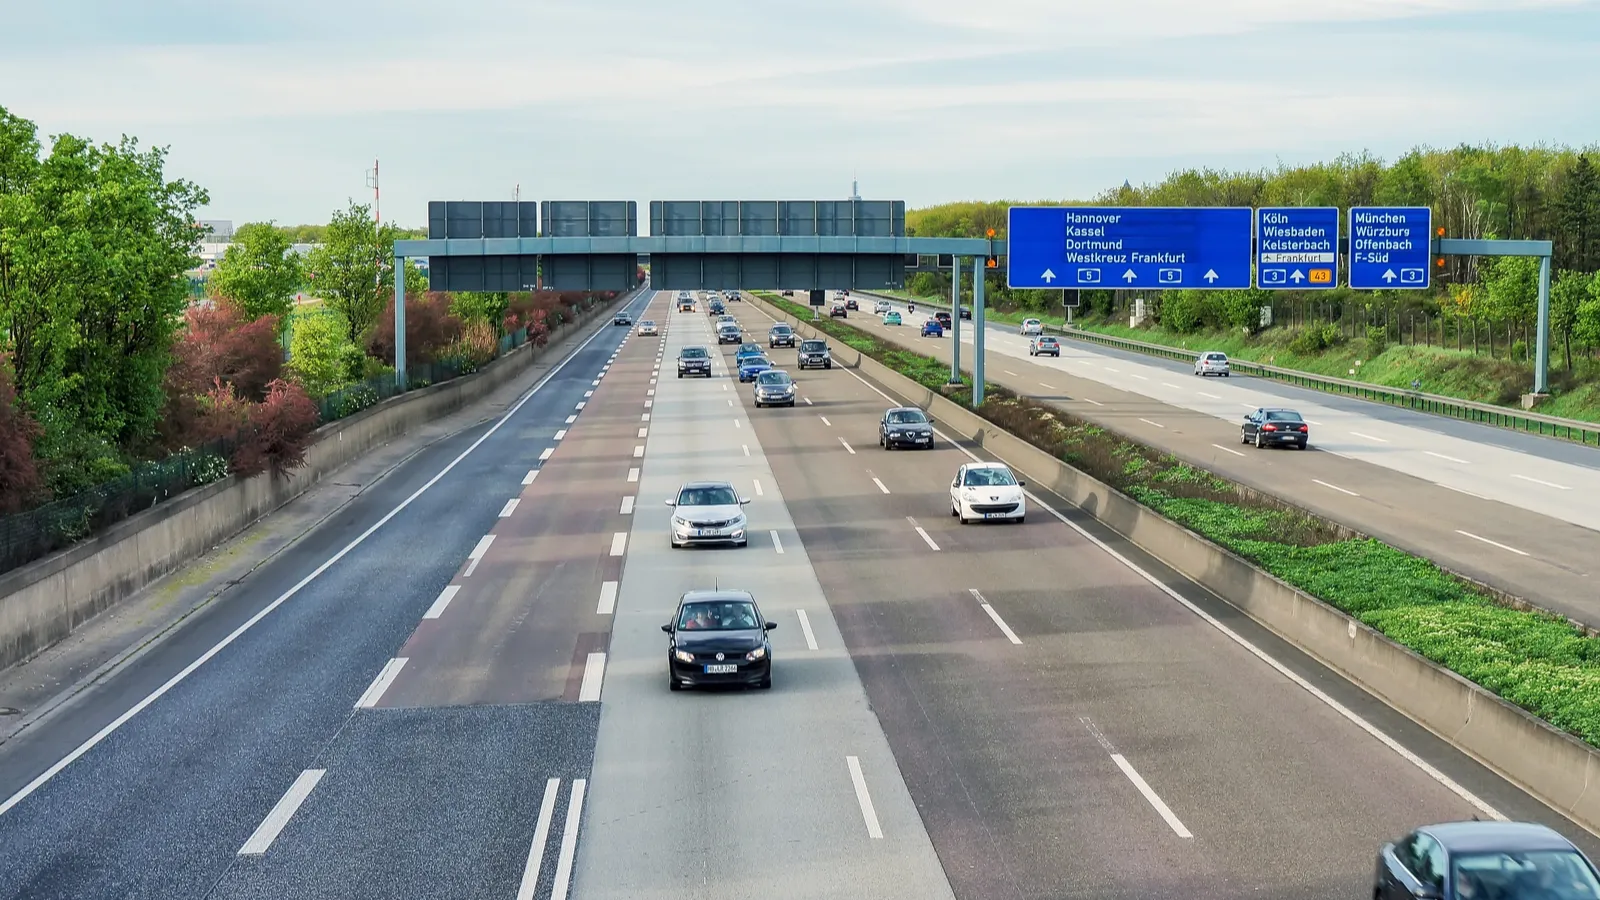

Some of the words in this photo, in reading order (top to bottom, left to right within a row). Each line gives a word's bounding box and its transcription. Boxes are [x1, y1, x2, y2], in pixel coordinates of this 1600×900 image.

[1066, 212, 1121, 223] Hannover
[1263, 212, 1288, 224] Köln
[1355, 212, 1406, 224] München
[1066, 226, 1105, 237] Kassel
[1263, 226, 1325, 237] Wiesbaden
[1355, 226, 1410, 237] Würzburg
[1066, 239, 1123, 250] Dortmund
[1263, 239, 1330, 250] Kelsterbach
[1355, 239, 1412, 250] Offenbach
[1066, 252, 1127, 263] Westkreuz
[1131, 252, 1185, 263] Frankfurt
[1276, 253, 1322, 263] Frankfurt
[1355, 252, 1389, 263] F-Süd
[1314, 271, 1326, 280] 43
